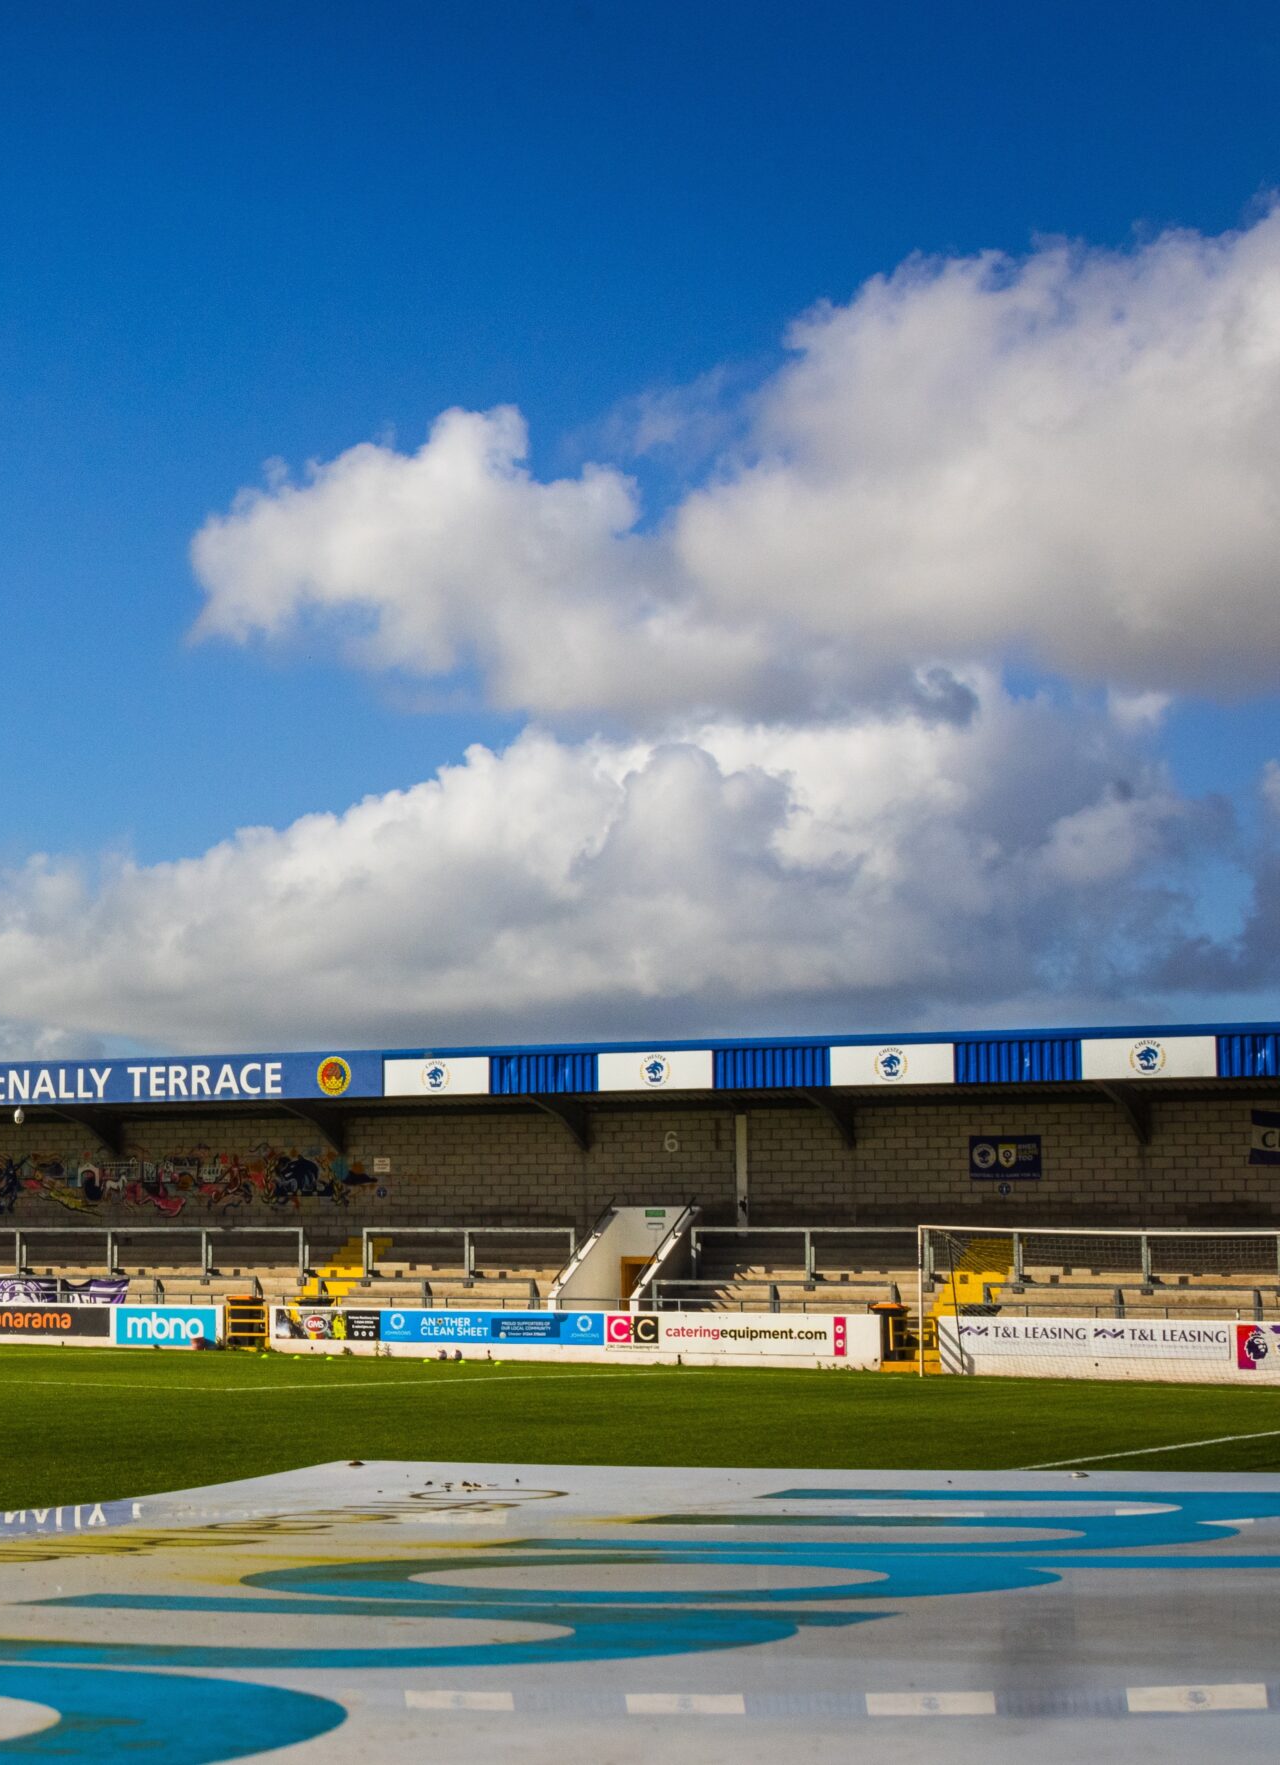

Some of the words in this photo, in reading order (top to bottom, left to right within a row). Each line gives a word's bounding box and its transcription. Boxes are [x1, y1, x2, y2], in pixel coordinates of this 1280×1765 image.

[126, 1062, 283, 1098] TERRACE
[664, 1131, 679, 1153] 6
[127, 1311, 205, 1340] mbna
[307, 1319, 324, 1329] GMS
[420, 1326, 455, 1336] CLEAN
[457, 1327, 488, 1337] SHEET
[610, 1318, 656, 1341] C&C
[665, 1326, 827, 1341] cateringequipment.com
[993, 1325, 1020, 1338] T&L
[1025, 1326, 1087, 1340] LEASING
[1128, 1328, 1158, 1341] T&L
[1162, 1329, 1227, 1343] LEASING
